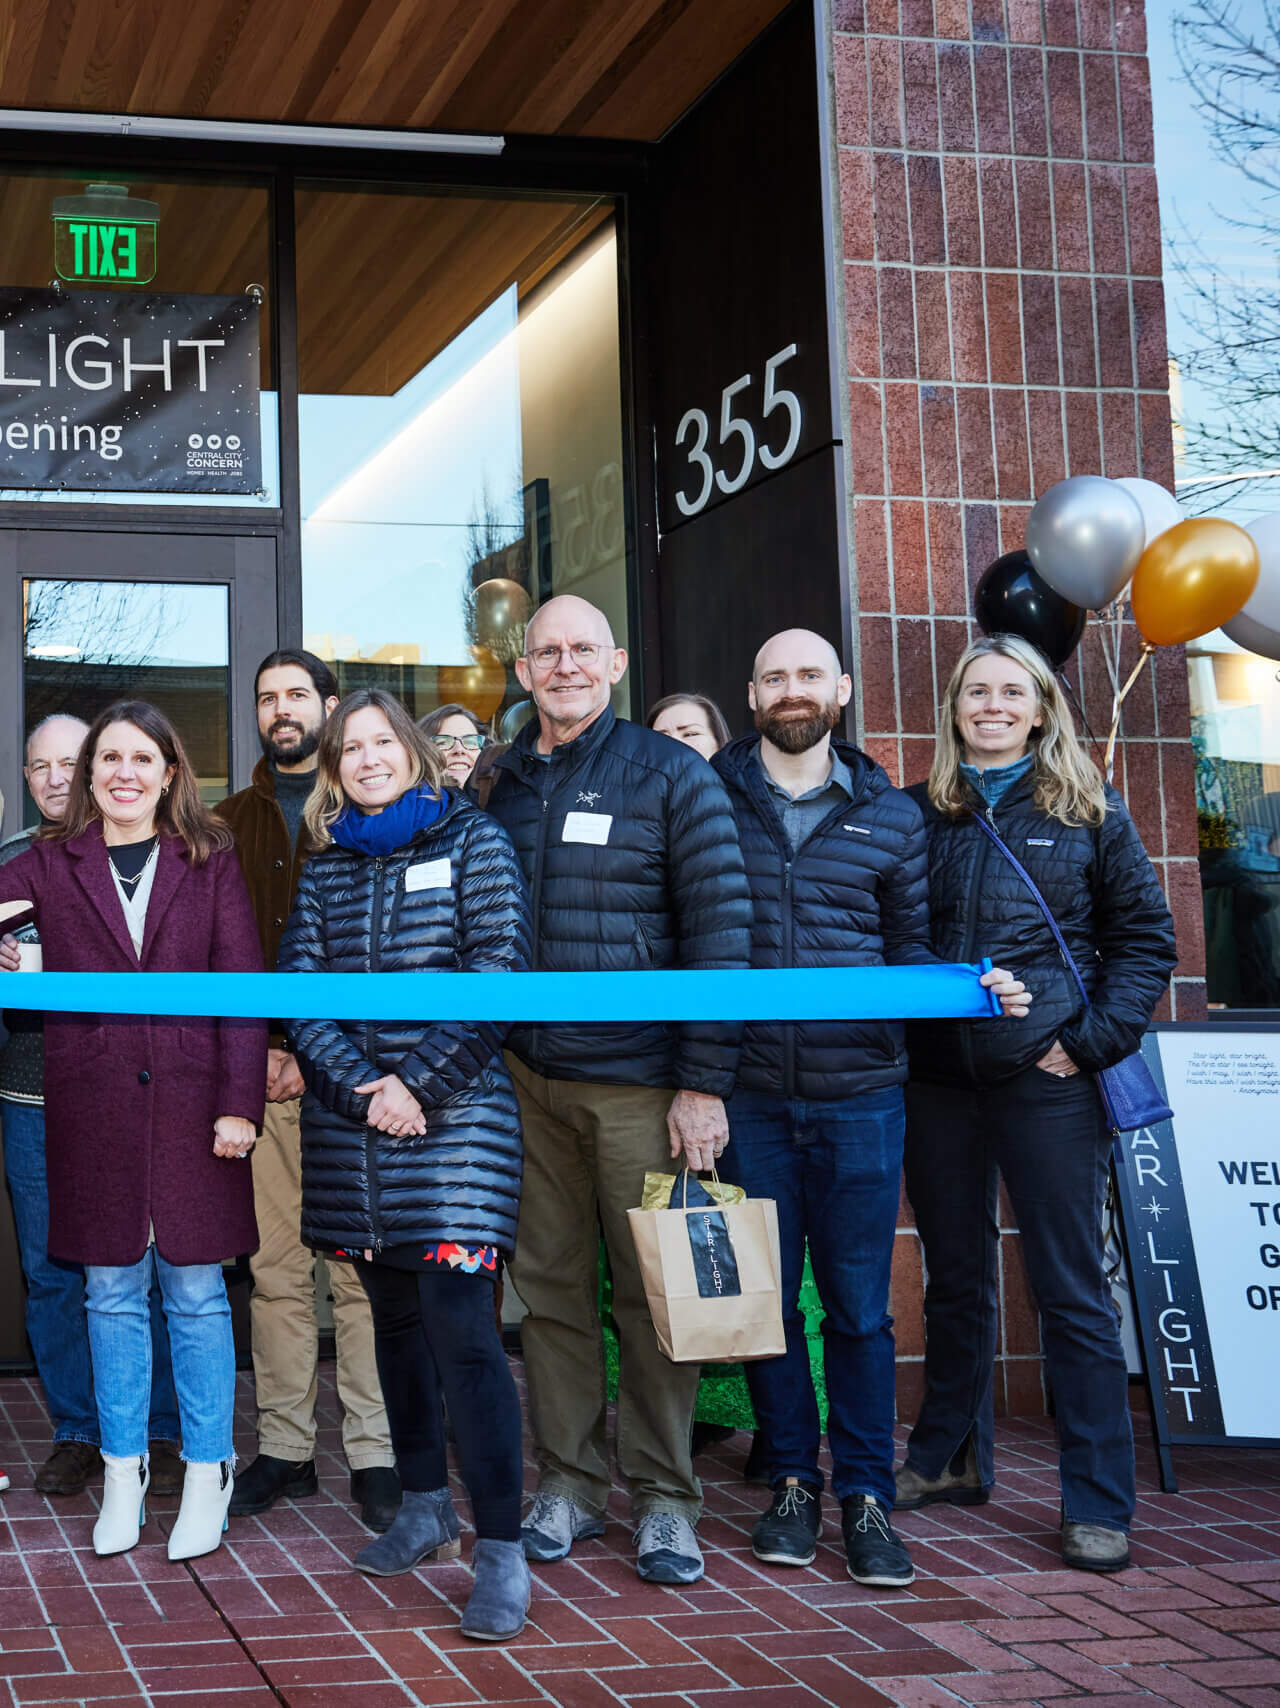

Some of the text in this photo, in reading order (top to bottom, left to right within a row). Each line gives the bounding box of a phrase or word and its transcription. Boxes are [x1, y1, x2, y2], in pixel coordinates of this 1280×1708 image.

[186, 451, 242, 460] CENTRAL CITY
[186, 458, 243, 468] CONCERN
[675, 343, 802, 516] 355
[1147, 1231, 1202, 1422] LIGHT
